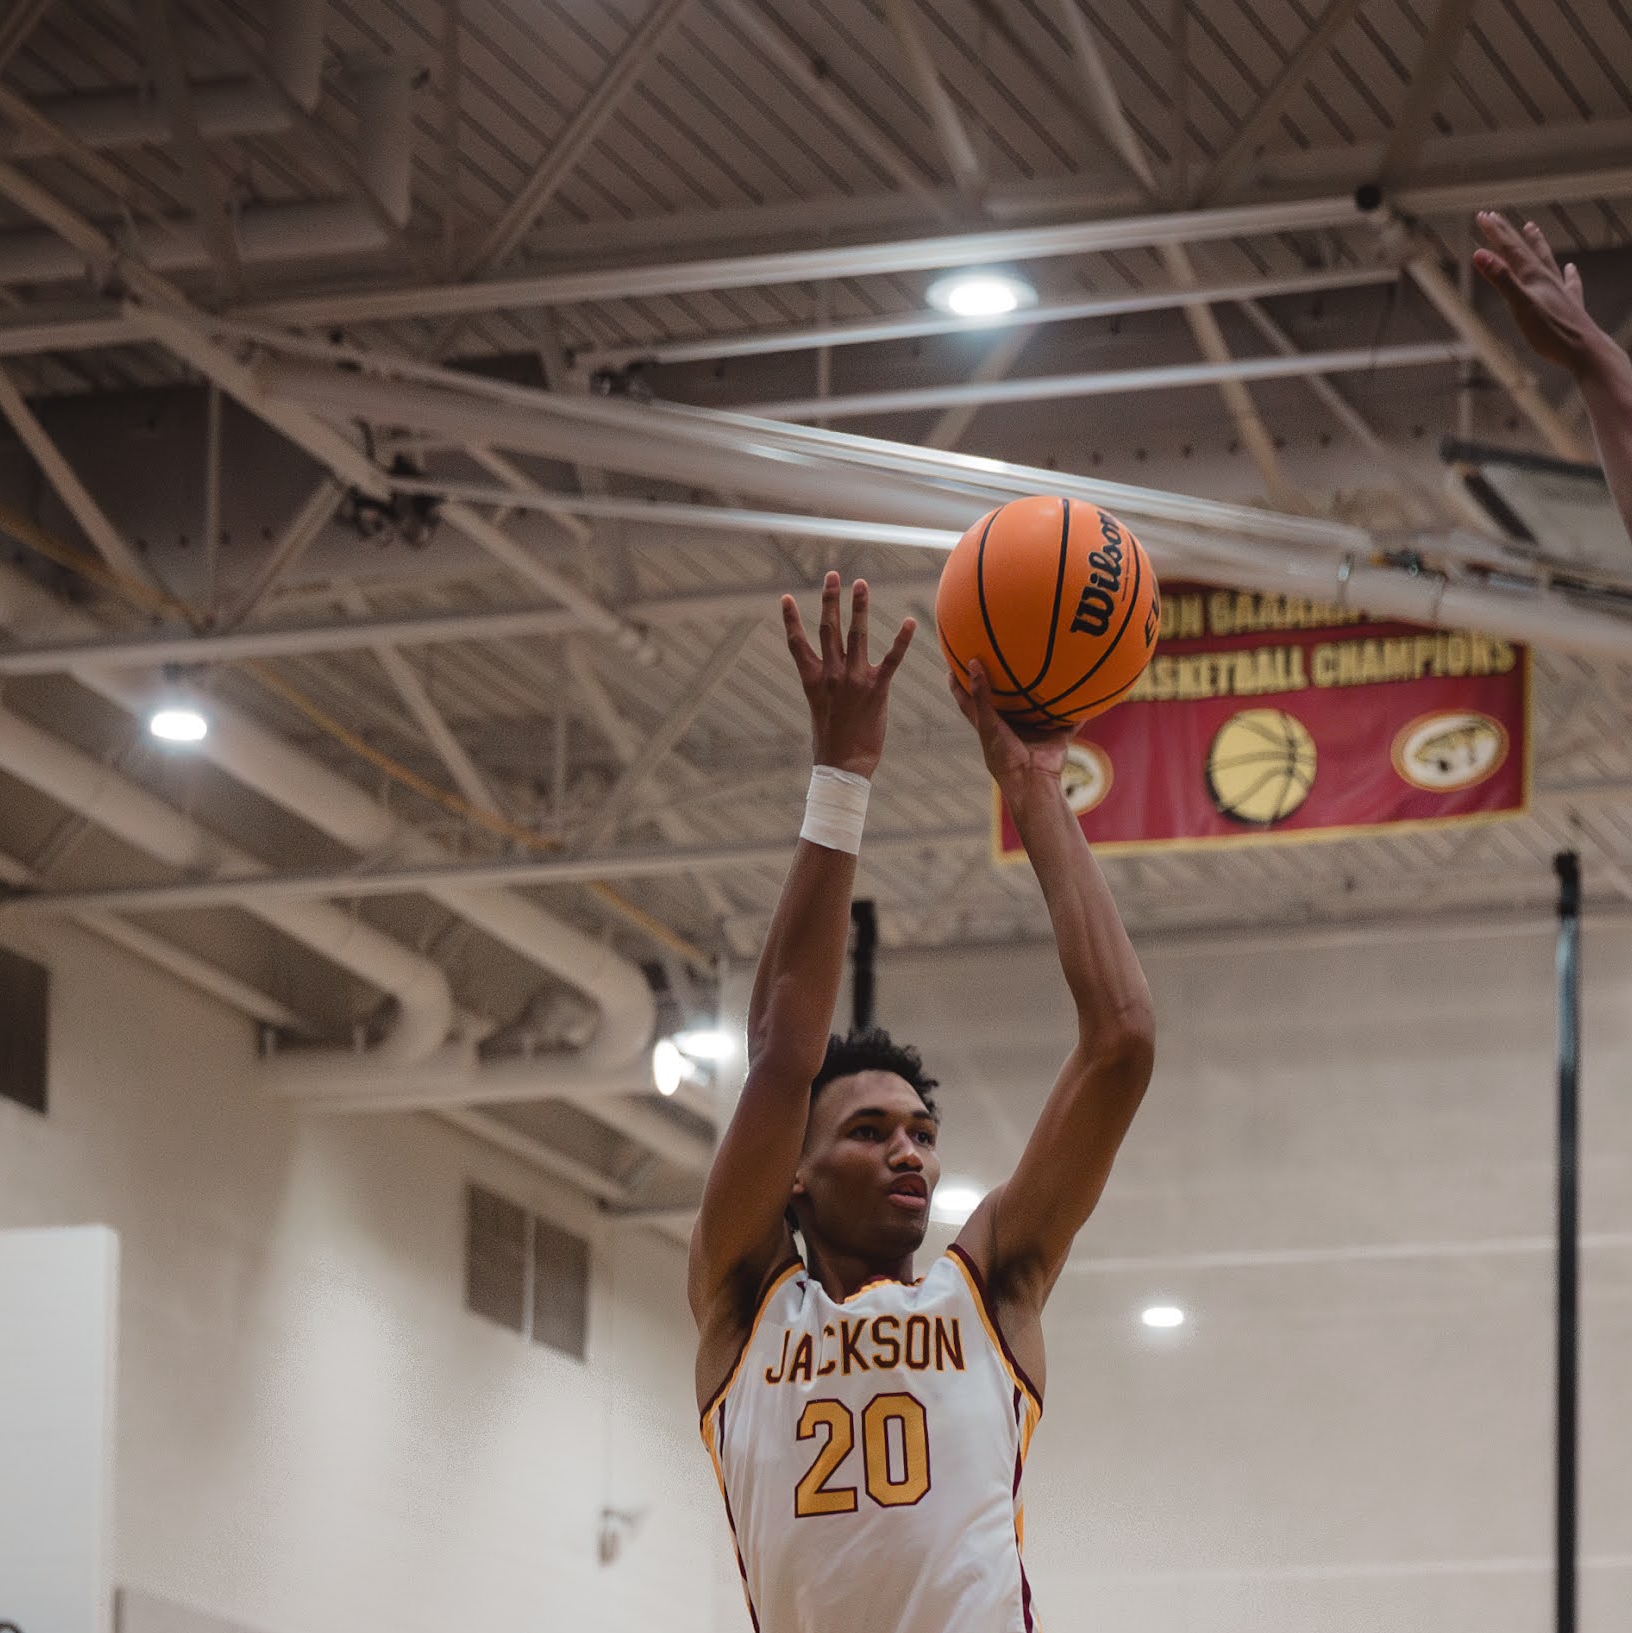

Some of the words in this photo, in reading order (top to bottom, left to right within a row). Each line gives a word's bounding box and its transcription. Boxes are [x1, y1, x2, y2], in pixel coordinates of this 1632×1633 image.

[1310, 626, 1517, 689] CHAMPIONS
[765, 1313, 966, 1386] JACKSON
[794, 1391, 932, 1519] 20
